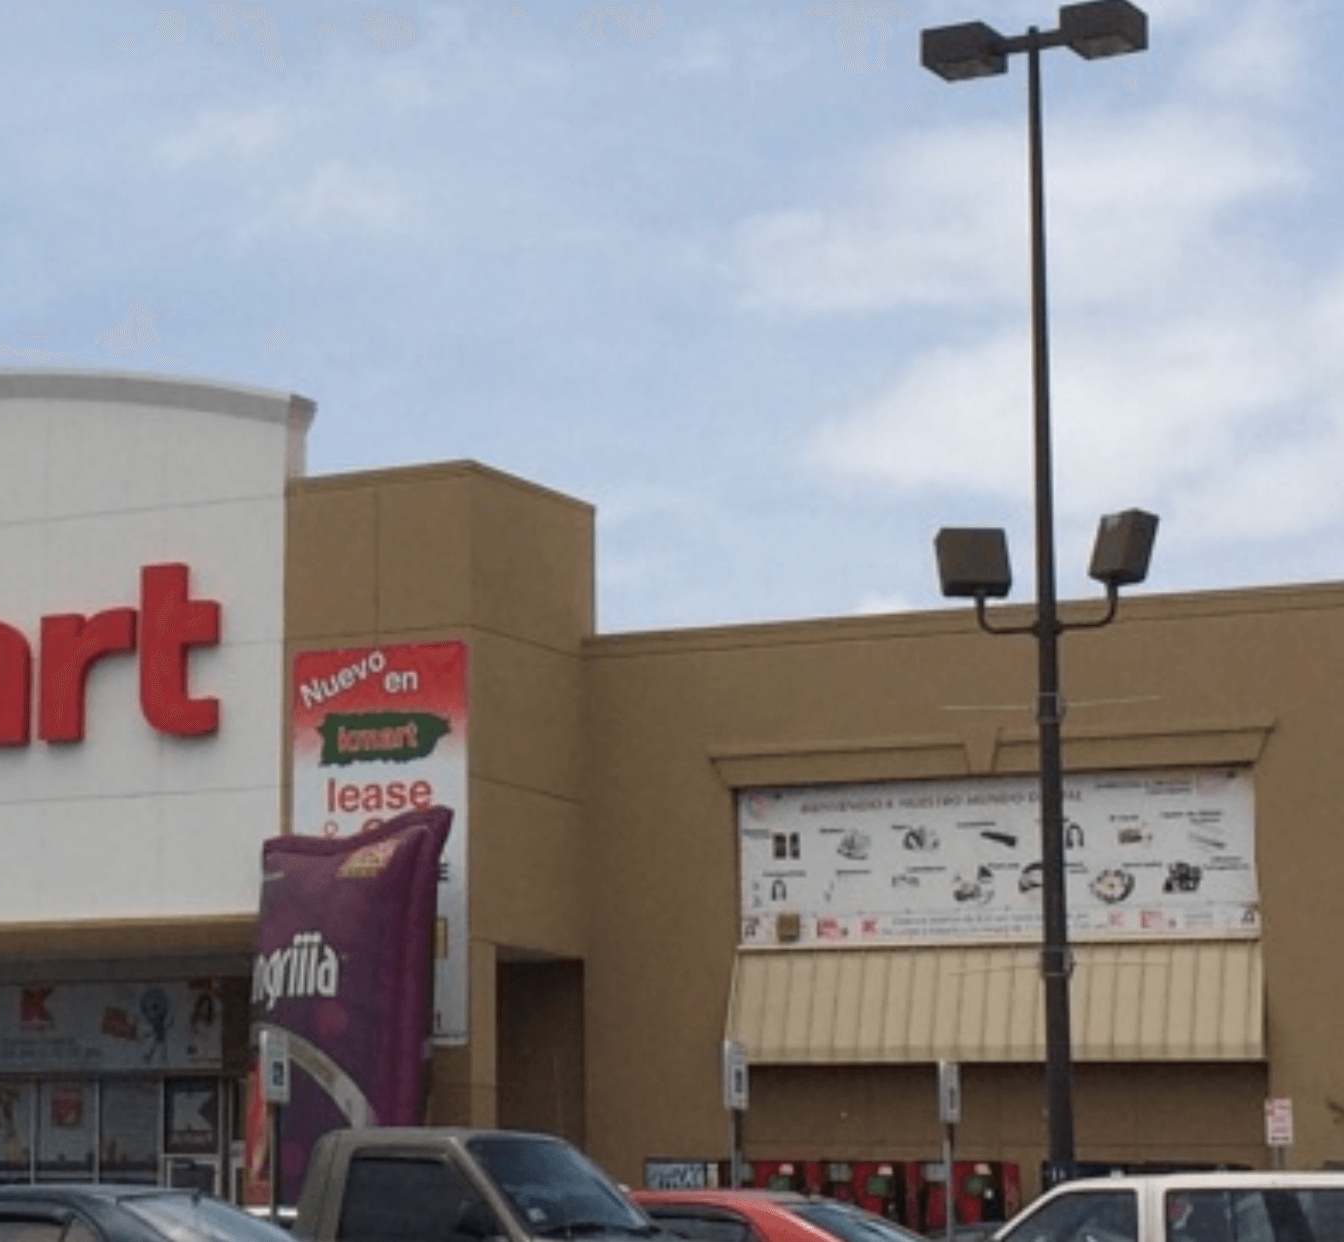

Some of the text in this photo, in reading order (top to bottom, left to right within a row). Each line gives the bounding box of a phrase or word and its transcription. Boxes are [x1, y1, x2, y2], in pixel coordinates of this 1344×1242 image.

[300, 650, 419, 708] Nuevo en
[327, 777, 432, 813] lease
